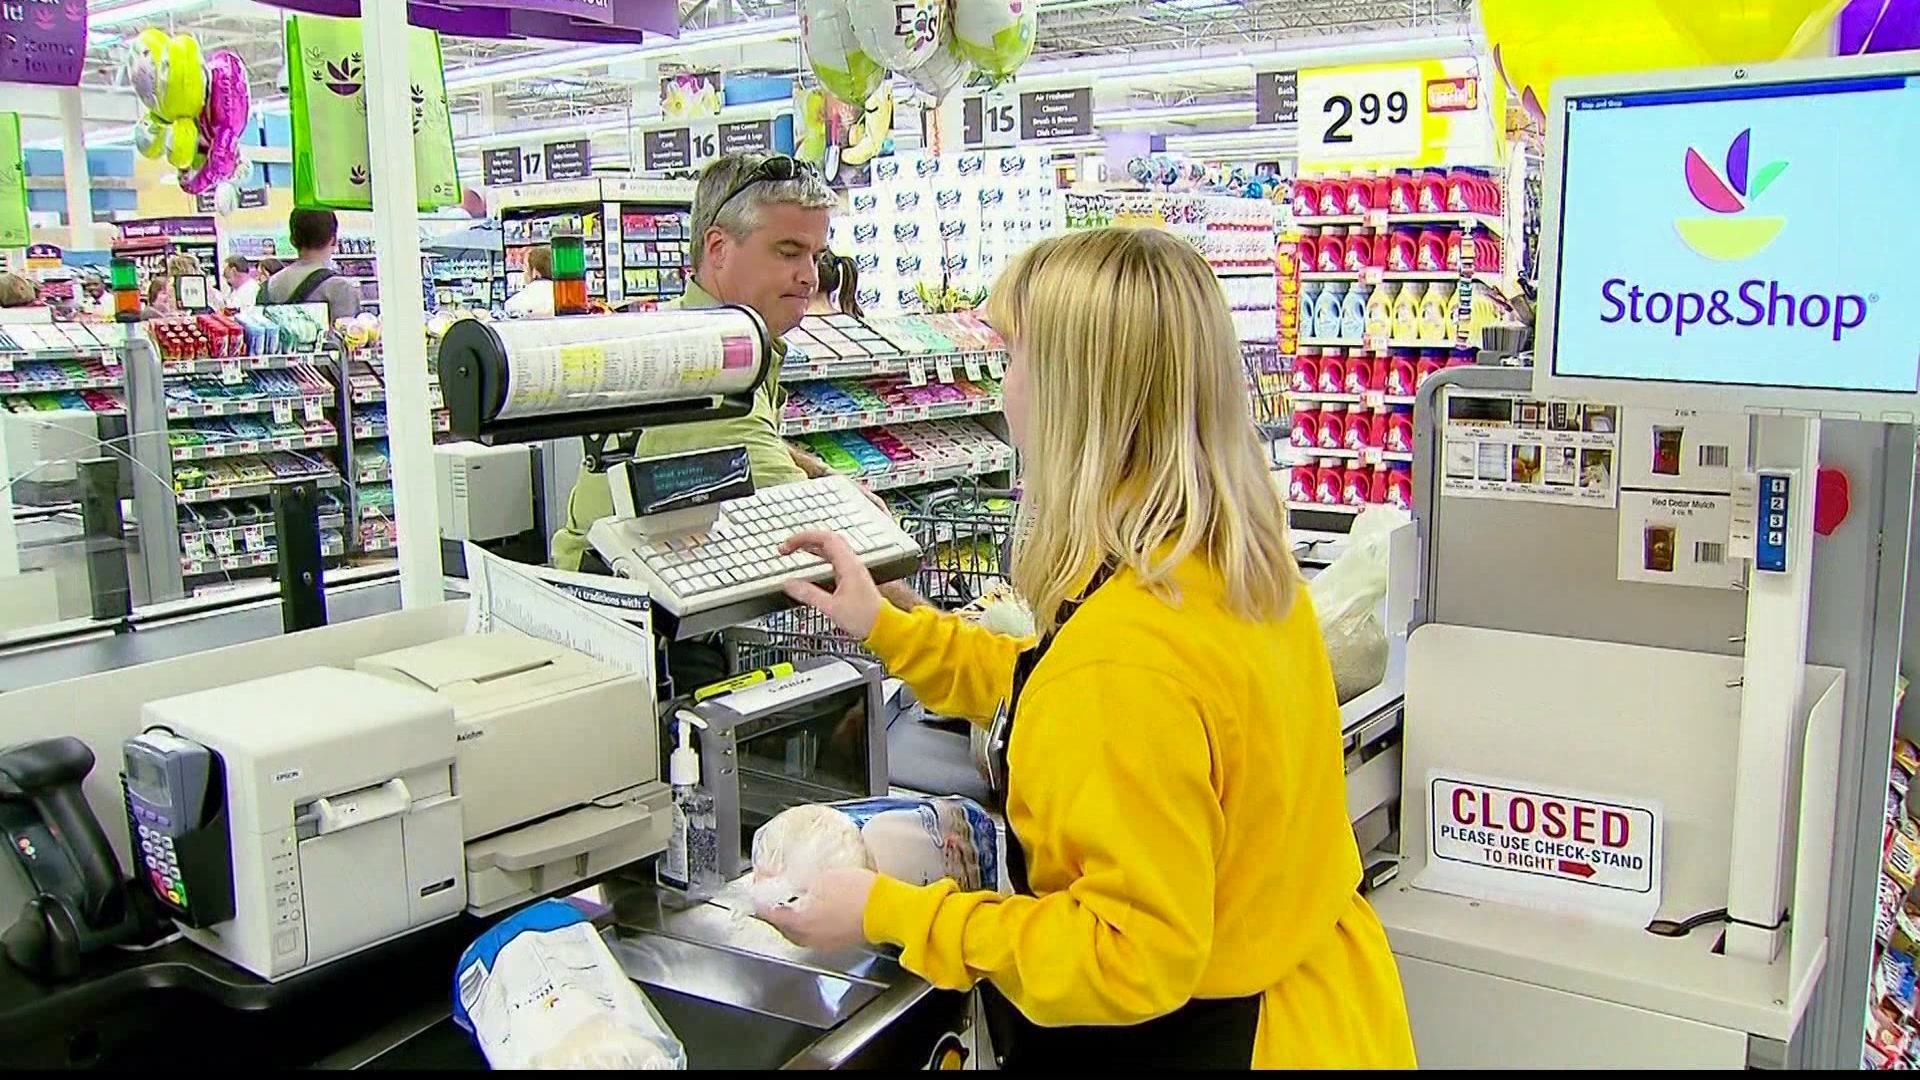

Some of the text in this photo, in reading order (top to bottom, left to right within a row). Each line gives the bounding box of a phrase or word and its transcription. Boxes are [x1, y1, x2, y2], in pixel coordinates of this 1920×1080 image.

[1045, 91, 1075, 100] Freshener
[986, 105, 1015, 132] 15
[693, 134, 715, 158] 16
[523, 153, 541, 175] 17
[1600, 278, 1867, 341] Stop&Shop
[1652, 498, 1716, 509] Red Cedar Mulch
[584, 590, 620, 606] traditions
[621, 597, 642, 609] with
[1451, 787, 1630, 848] CLOSED
[1441, 825, 1643, 870] PLEASE USE CHECK-STAND
[1484, 848, 1555, 870] TO RIGHT
